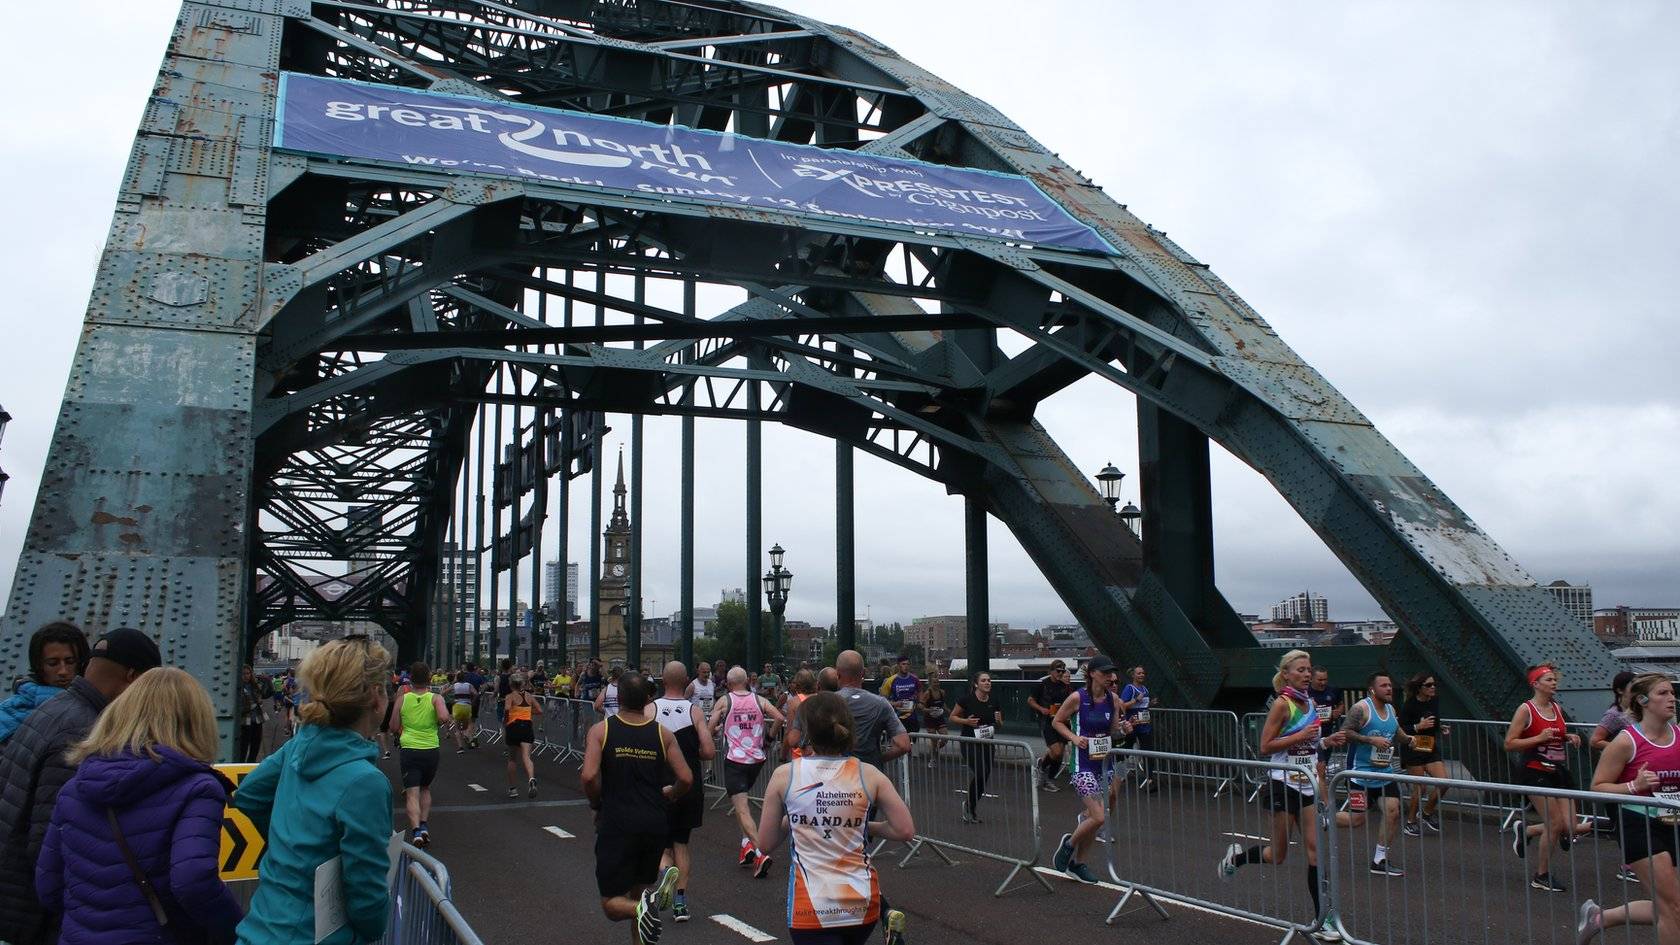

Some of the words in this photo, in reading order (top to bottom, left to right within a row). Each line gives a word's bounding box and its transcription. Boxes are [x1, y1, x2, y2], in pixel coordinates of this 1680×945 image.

[325, 101, 491, 134] great
[552, 128, 712, 171] north
[816, 791, 862, 799] Alzheimer's
[816, 799, 854, 807] Research
[791, 813, 863, 828] GRANDAD
[823, 829, 832, 839] X
